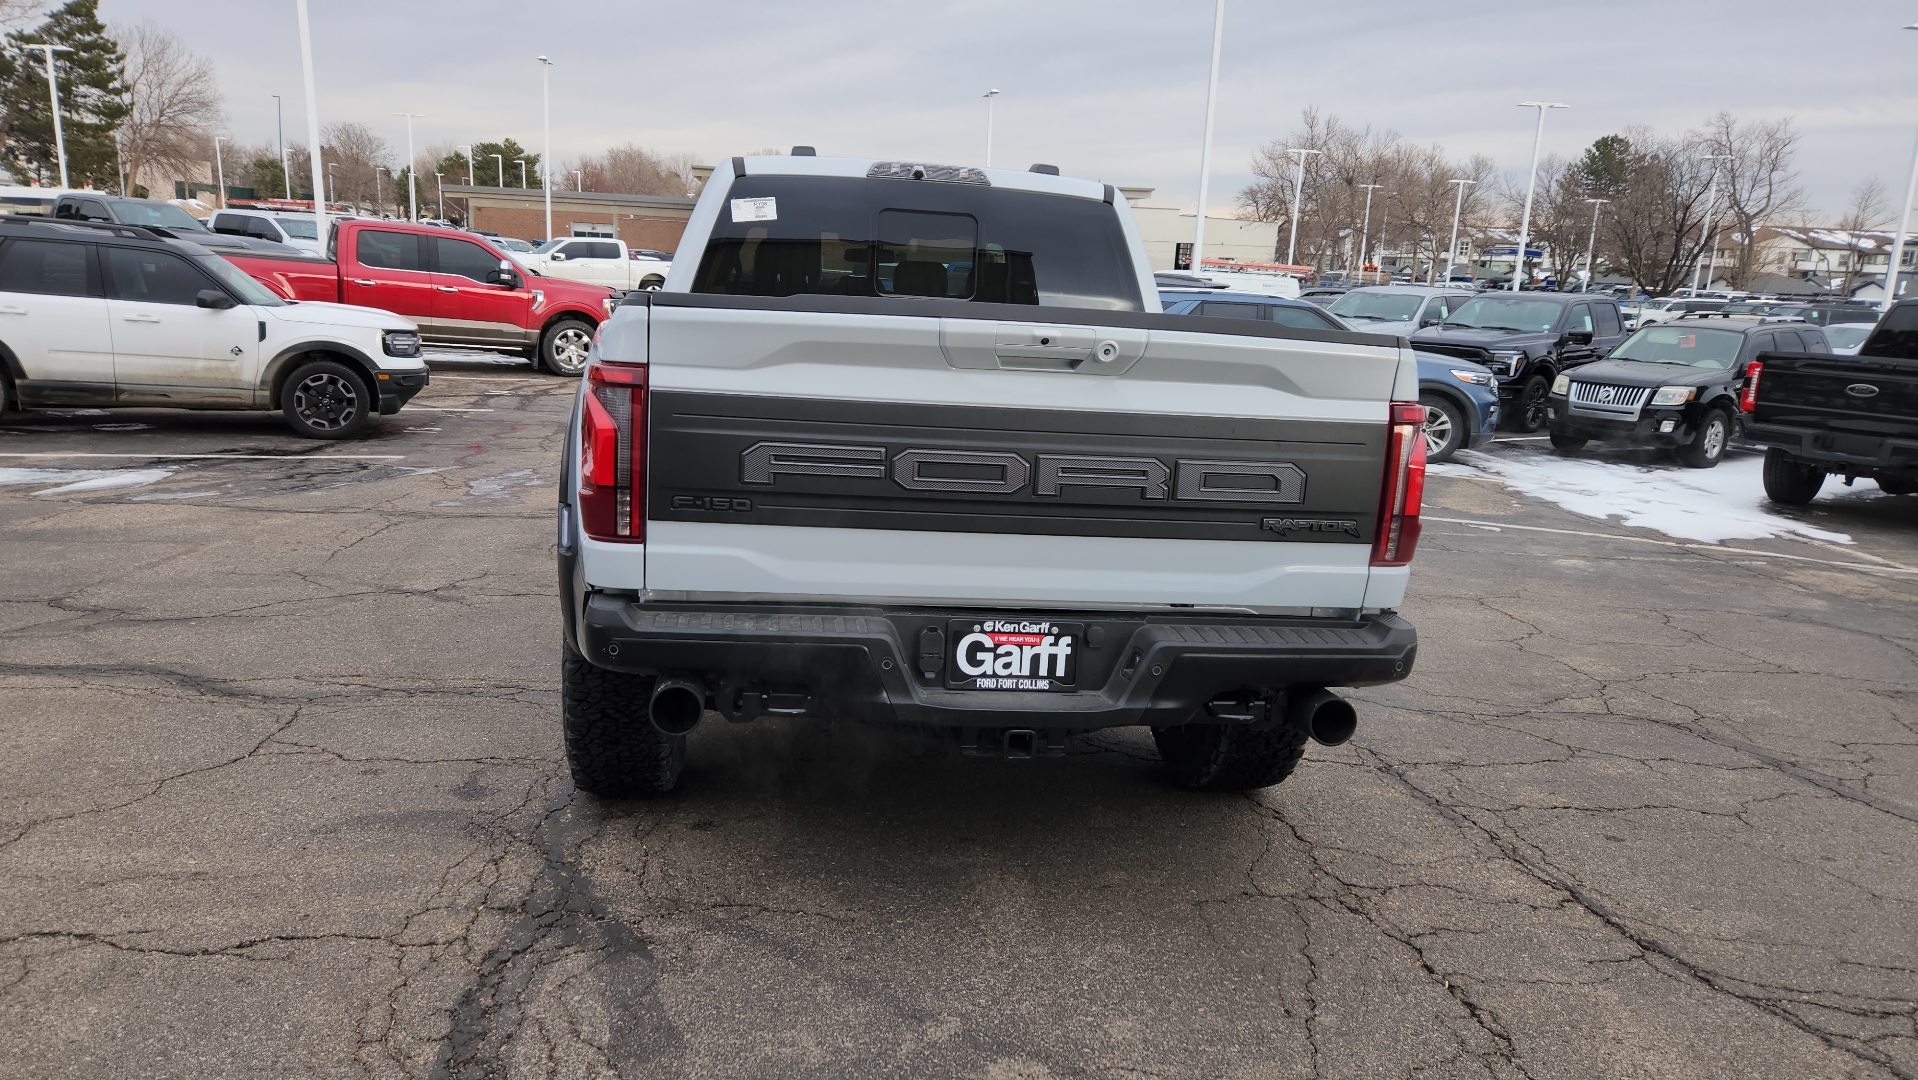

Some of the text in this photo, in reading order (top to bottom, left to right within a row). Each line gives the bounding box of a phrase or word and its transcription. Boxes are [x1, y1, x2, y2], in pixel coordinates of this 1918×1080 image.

[739, 440, 1307, 504] FORD
[671, 495, 752, 512] F-150
[1261, 518, 1360, 538] RAPTOR
[995, 621, 1049, 633] Ken Garff
[956, 633, 1072, 677] Garff
[976, 678, 1049, 690] FORD FORT COLLINS
